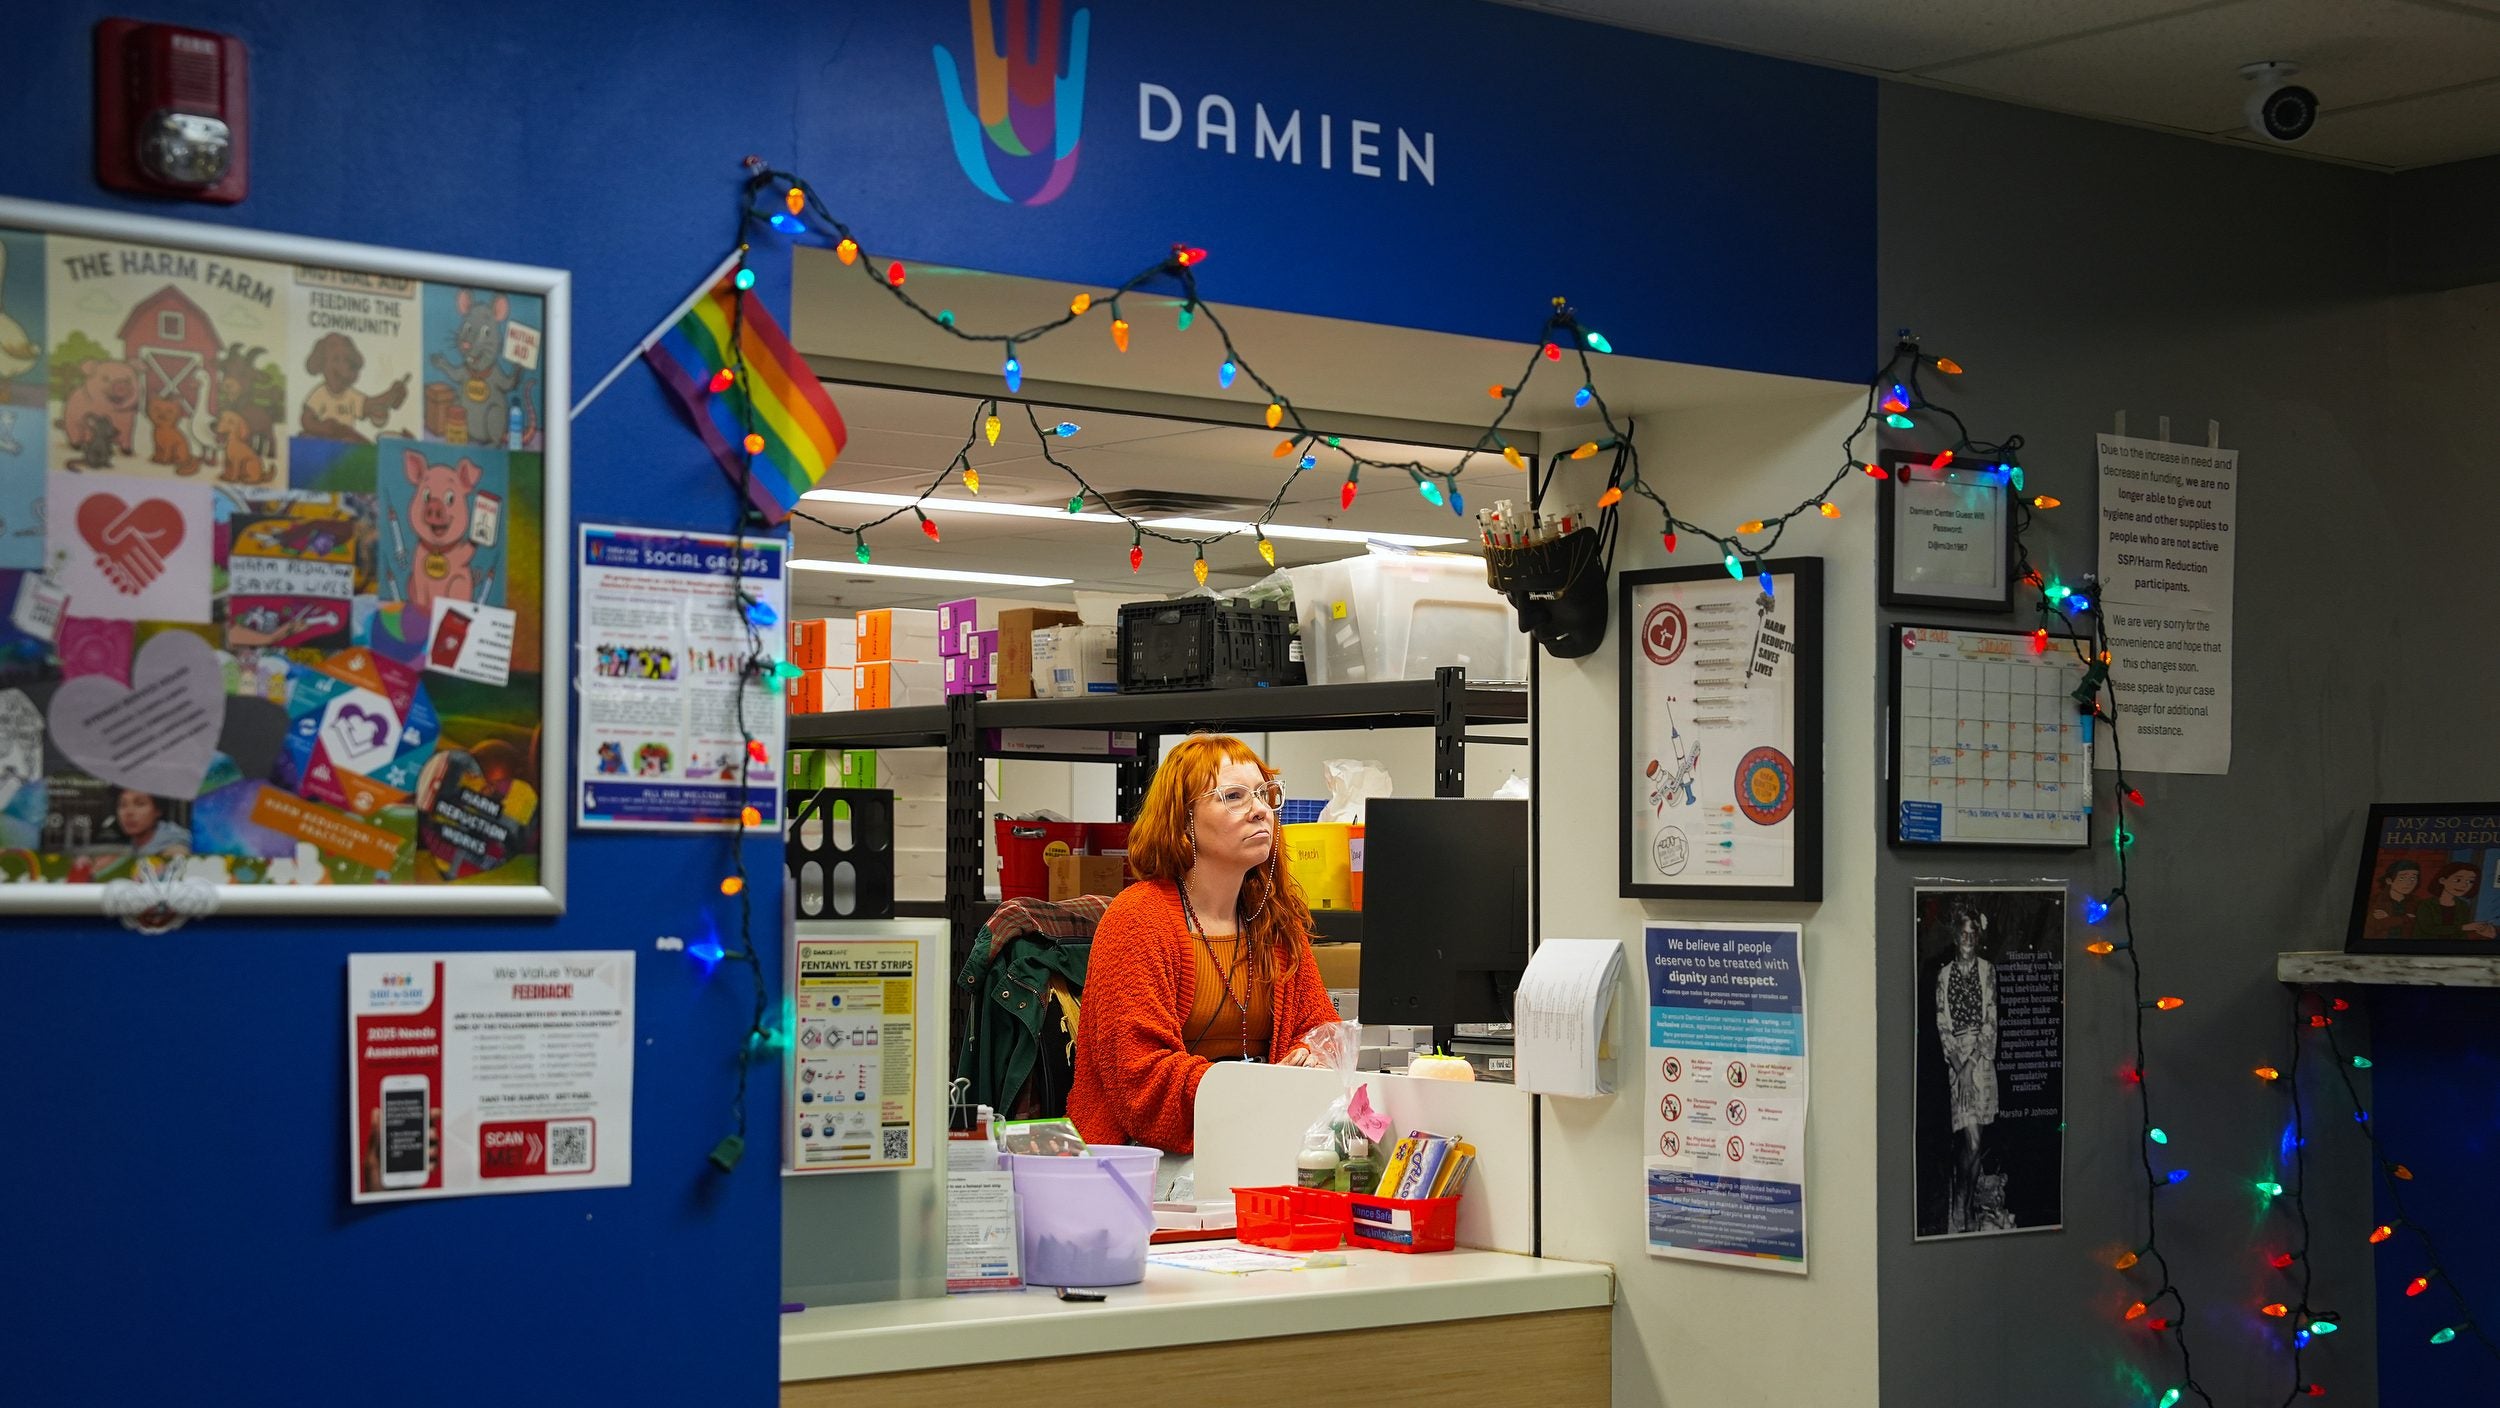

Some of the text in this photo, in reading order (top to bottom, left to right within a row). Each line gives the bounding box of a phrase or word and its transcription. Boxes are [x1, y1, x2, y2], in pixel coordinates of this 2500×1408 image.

[1139, 82, 1435, 187] DAMIEN
[63, 250, 274, 308] THE HARM FARM
[311, 291, 401, 317] FEEDING THE
[309, 311, 401, 337] COMMUNITY
[509, 328, 535, 347] MUTUAL
[2100, 443, 2232, 470] Due to the increase in need and
[2103, 464, 2230, 490] decrease in funding, we are no
[2118, 487, 2212, 509] longer able to give out
[1934, 508, 1954, 517] Center
[2103, 507, 2229, 532] hygiene and other supplies to
[2110, 531, 2219, 552] people who are not active
[644, 550, 701, 568] SOCIAL
[2118, 553, 2208, 574] SSP/Harm Reduction
[2135, 578, 2190, 593] participants.
[1764, 619, 1786, 635] HARM
[2113, 614, 2210, 632] We are very sorry for the
[2105, 637, 2222, 653] nconvenience and hope that
[1758, 647, 1780, 664] SAVES
[1754, 661, 1773, 677] LIVES
[2123, 658, 2199, 673] this changes soon.
[2137, 682, 2164, 695] speak
[2166, 684, 2174, 694] to
[2174, 685, 2192, 697] your
[2193, 685, 2215, 696] case
[2116, 702, 2208, 717] manager for additional
[2137, 724, 2184, 736] assistance.
[264, 798, 298, 818] HARM
[461, 790, 500, 816] HARM
[436, 800, 507, 841] REDUCTION
[2396, 817, 2427, 830] MY
[300, 822, 354, 850] PRACTICE
[441, 826, 486, 854] WORKS
[2386, 832, 2447, 844] HARM
[1668, 939, 1772, 955] We believe all people
[801, 960, 913, 970] FENTANYL TEST STRIPS
[1655, 954, 1789, 970] deserve to be treated with
[494, 966, 595, 979] We Value Your
[1669, 971, 1778, 988] dignity and respect.
[512, 984, 574, 1000] FEEDBACK!
[367, 1027, 436, 1041] 2025 Needs
[2041, 1029, 2056, 1038] very
[365, 1044, 438, 1059] Assessment
[2000, 1108, 2023, 1118] Marsha
[2031, 1107, 2058, 1117] Johnson
[485, 1132, 525, 1147] SCAN
[1376, 1209, 1392, 1221] Safe
